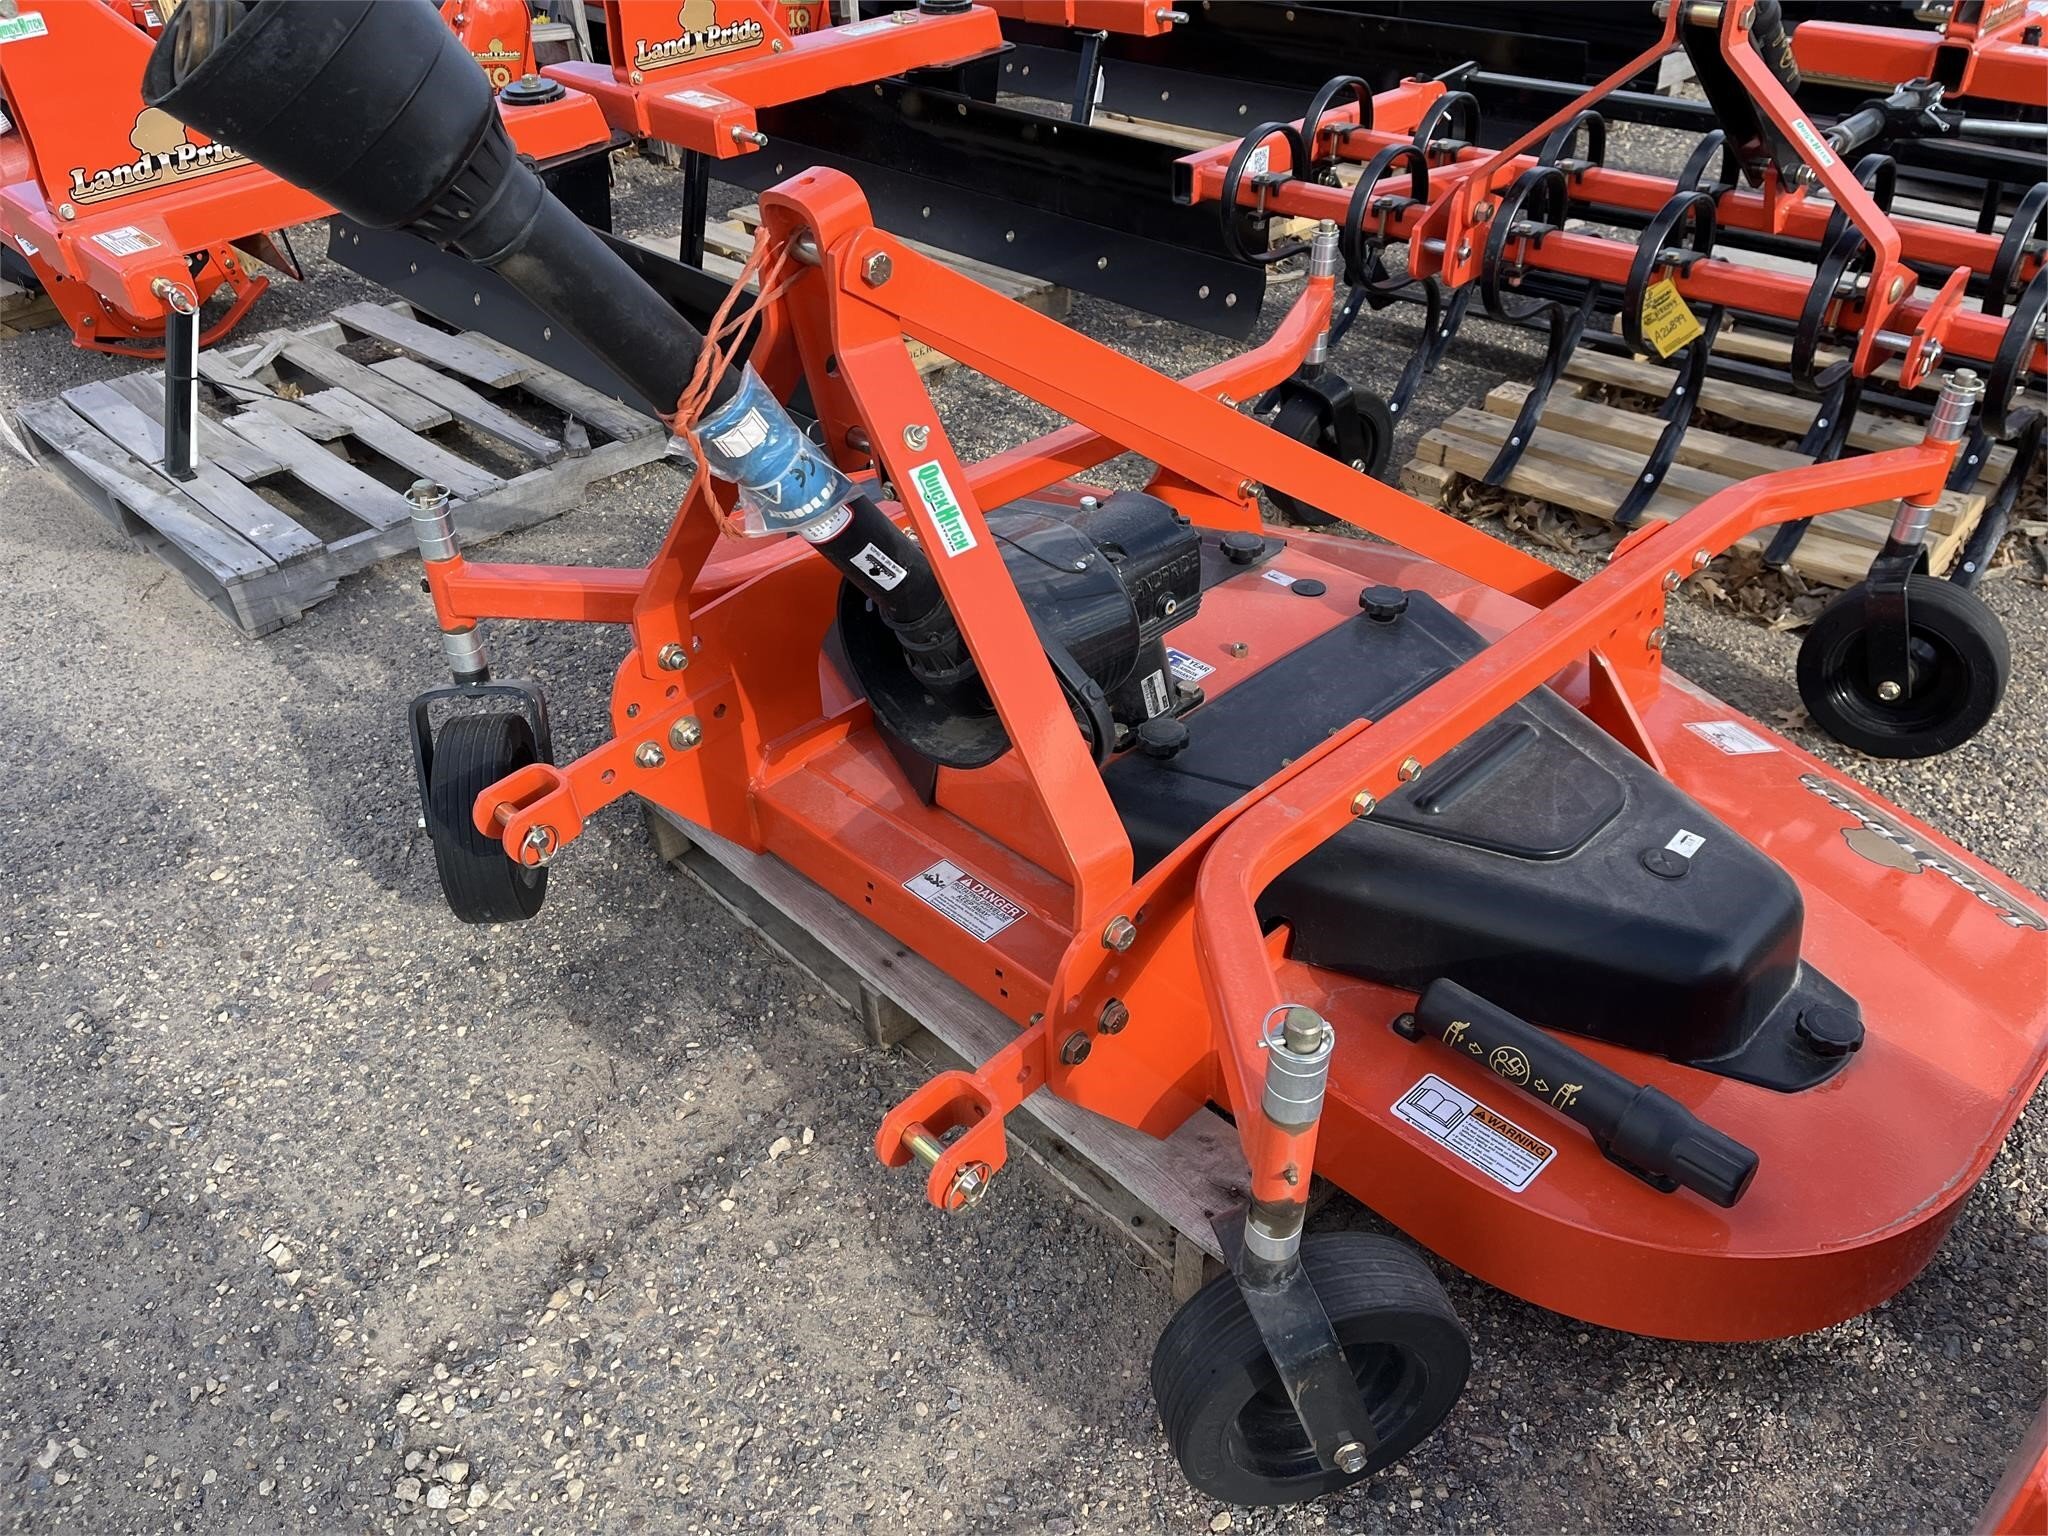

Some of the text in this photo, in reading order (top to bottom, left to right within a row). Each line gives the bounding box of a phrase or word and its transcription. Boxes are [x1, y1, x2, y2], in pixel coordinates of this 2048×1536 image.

[636, 18, 763, 64] Land Pride
[69, 152, 156, 196] Land
[1190, 660, 1210, 673] YEAR
[971, 883, 1021, 917] DANGER
[1487, 1116, 1547, 1157] WARNING
